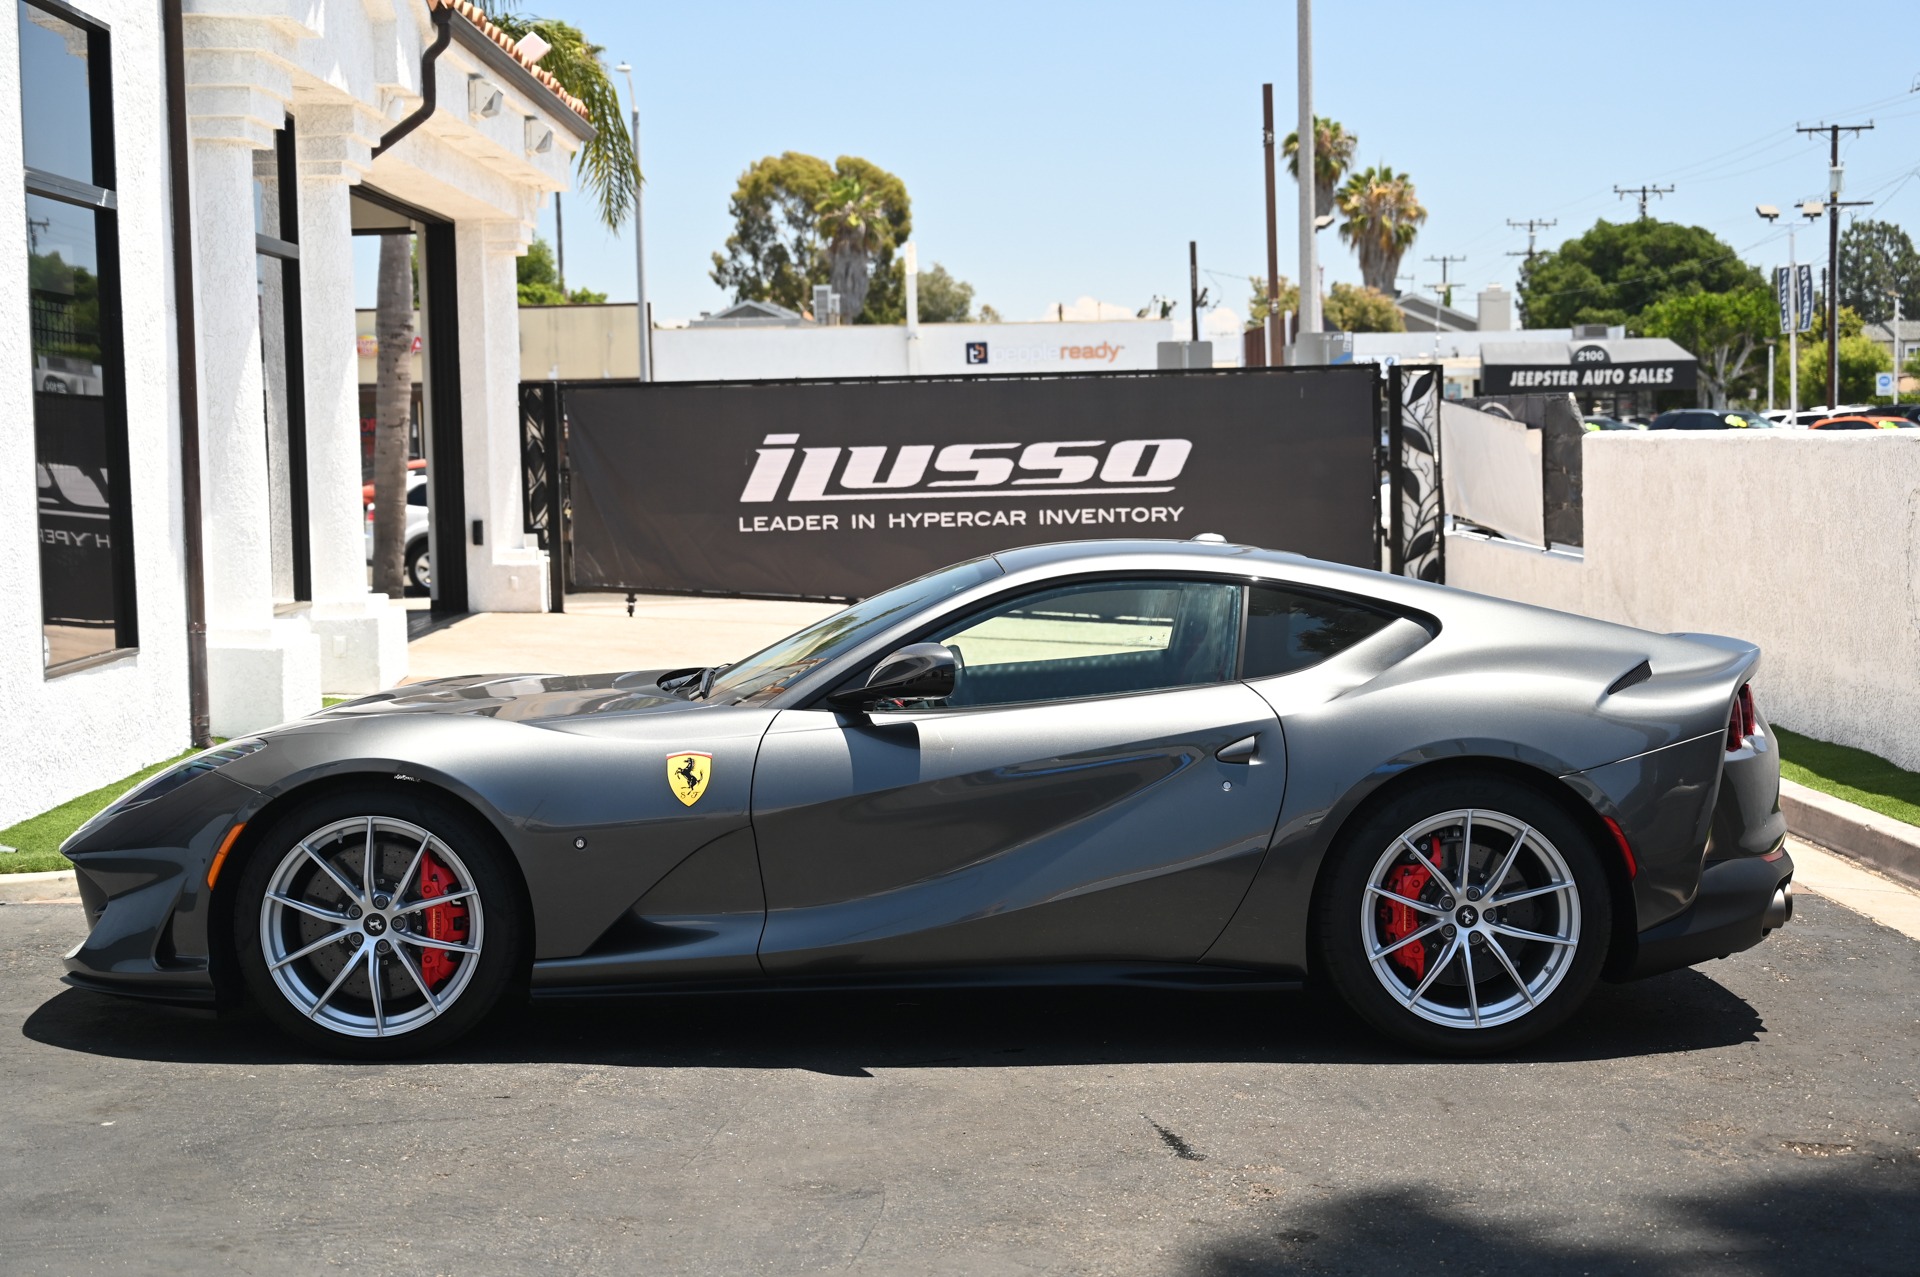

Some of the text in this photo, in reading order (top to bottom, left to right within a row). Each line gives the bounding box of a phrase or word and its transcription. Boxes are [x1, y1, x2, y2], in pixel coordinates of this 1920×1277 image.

[1577, 351, 1604, 361] 2100
[1510, 367, 1674, 387] JEEPSTER AUTO SALES
[739, 506, 1184, 532] LEADER IN HYPERCAR INVENTORY
